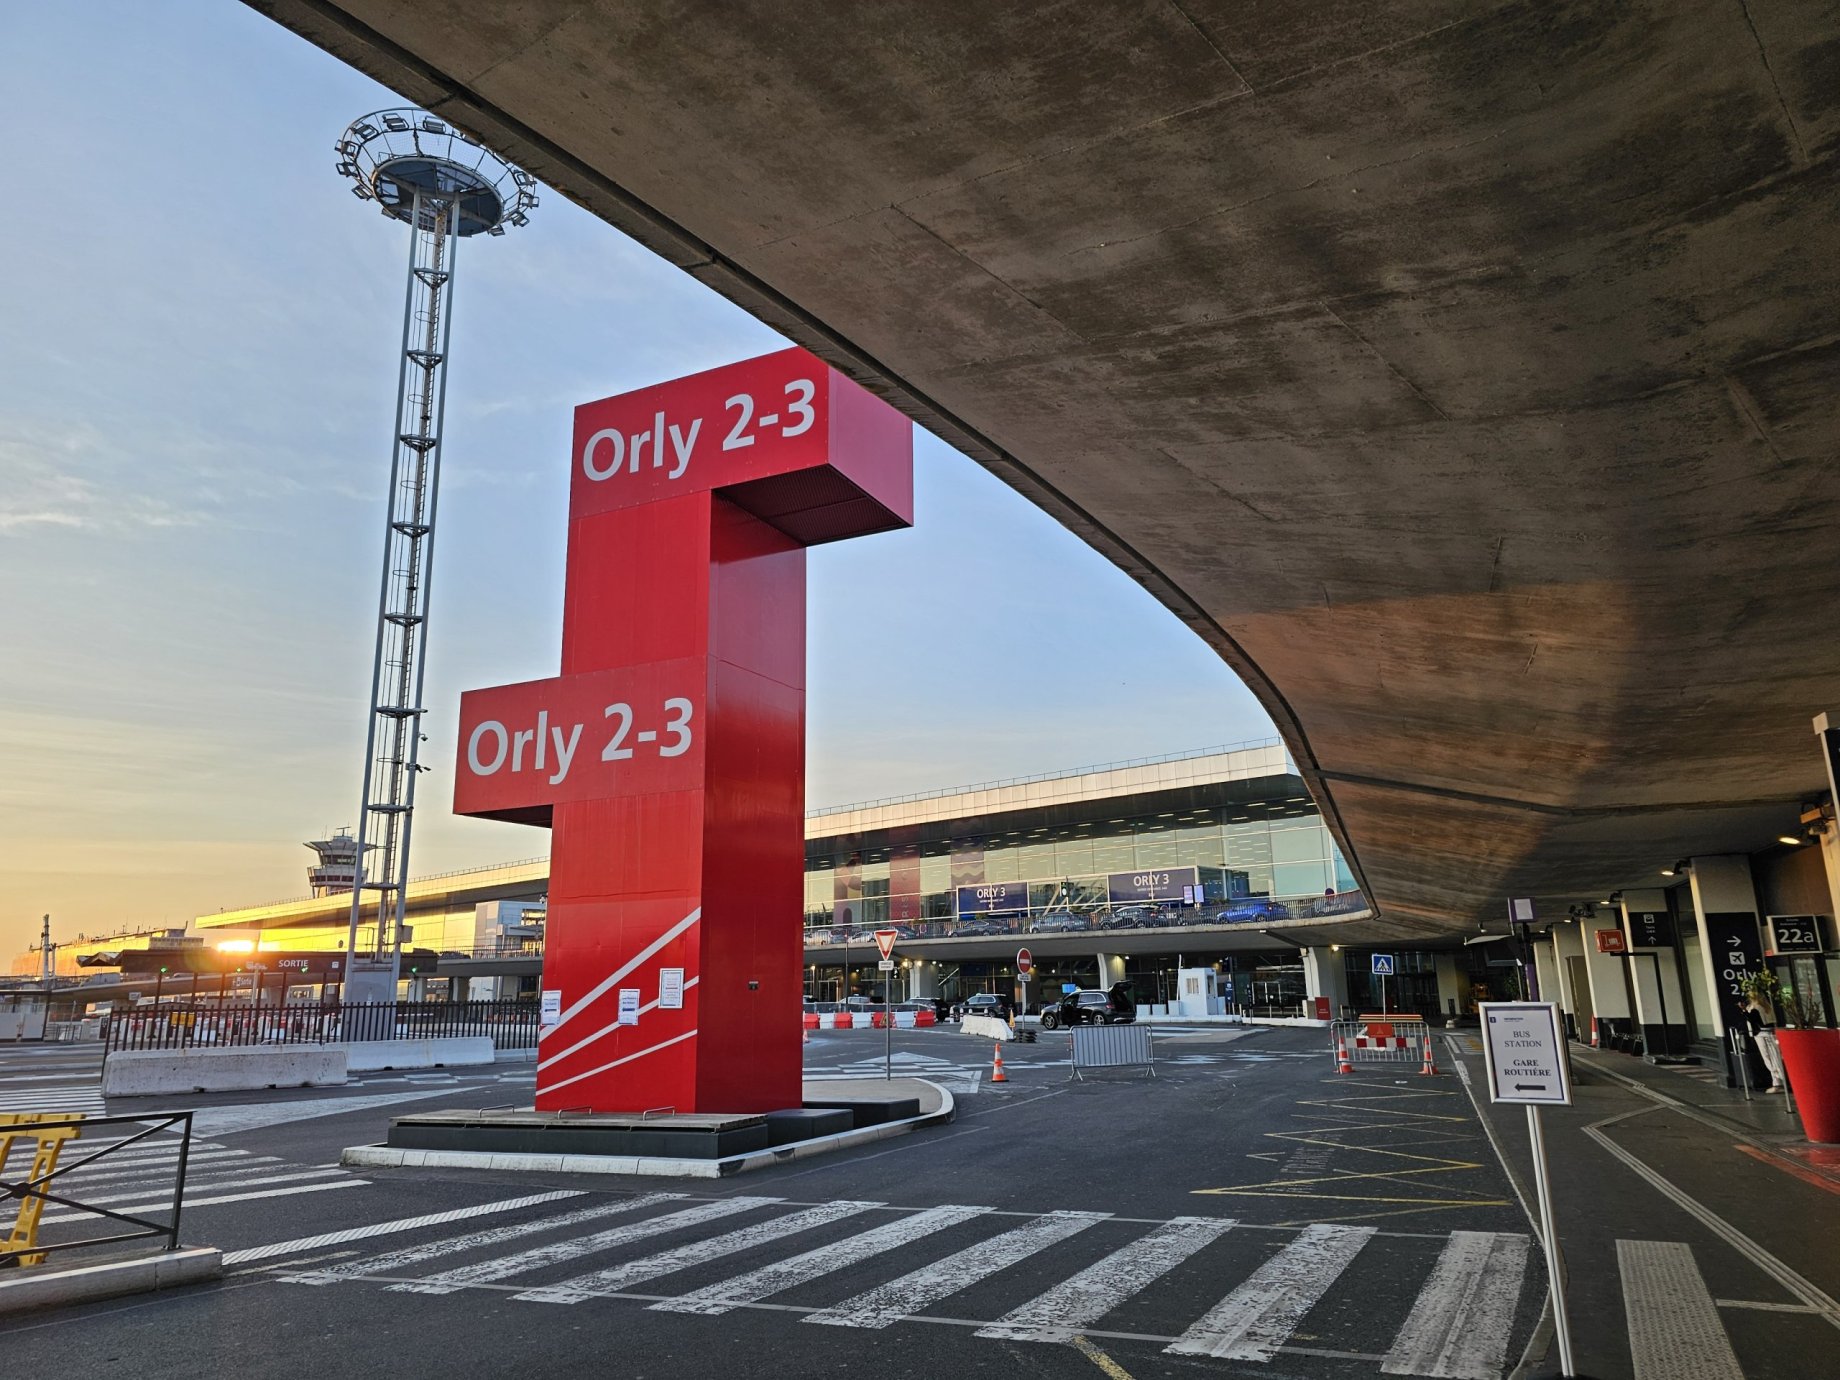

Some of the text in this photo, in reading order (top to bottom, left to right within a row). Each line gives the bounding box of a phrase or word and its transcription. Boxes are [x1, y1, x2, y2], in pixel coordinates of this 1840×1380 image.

[583, 379, 815, 481] Orly 2-3
[468, 697, 693, 785] Orly 2-3
[1133, 873, 1169, 887] ORLY 3
[976, 886, 1006, 899] ORLY 3
[1778, 928, 1815, 943] 22a
[278, 959, 309, 968] SORTIE
[1723, 968, 1758, 981] Orly
[1513, 1030, 1531, 1038] BUS
[1504, 1040, 1542, 1048] STATION
[1513, 1059, 1539, 1067] GARE
